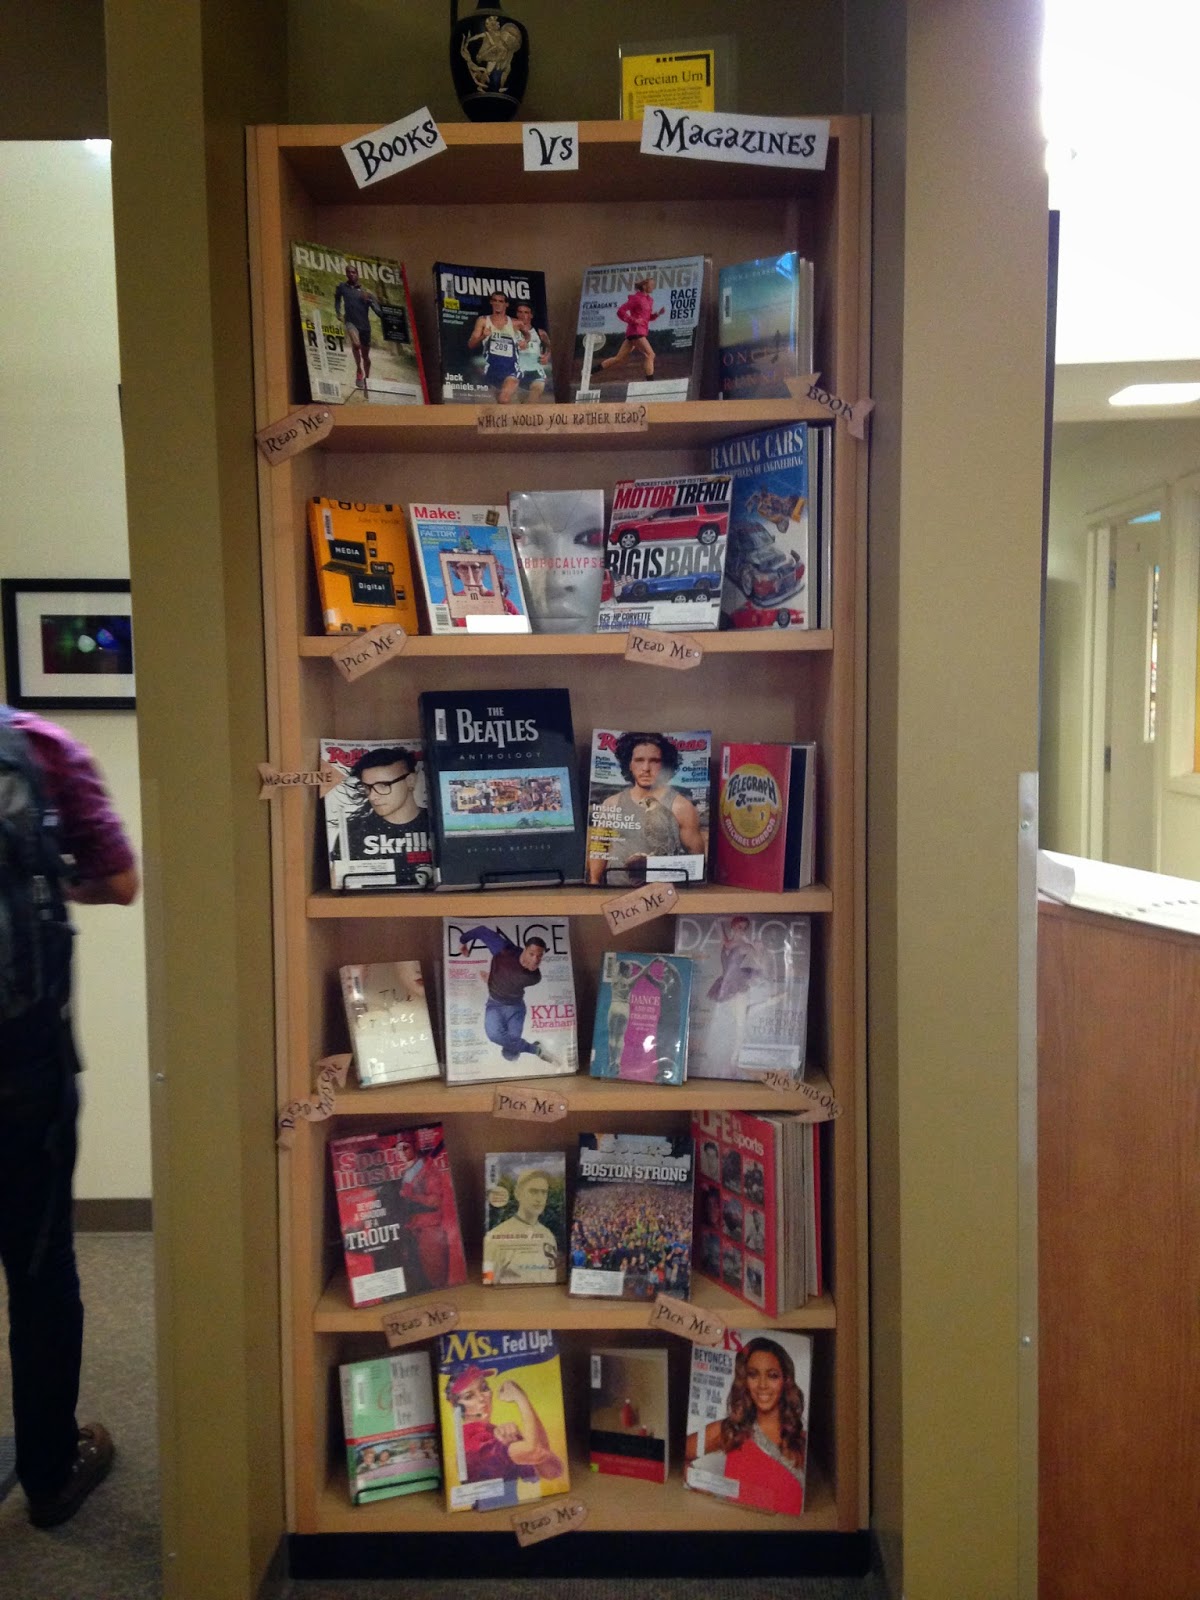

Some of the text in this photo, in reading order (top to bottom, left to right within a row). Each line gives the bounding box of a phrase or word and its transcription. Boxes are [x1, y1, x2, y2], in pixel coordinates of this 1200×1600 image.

[634, 71, 704, 86] Grecian Urn
[295, 246, 396, 285] RUNNING
[584, 267, 692, 296] RUNNING
[671, 288, 697, 300] RACE
[670, 298, 696, 310] YOUR
[670, 309, 695, 320] BEST
[308, 330, 346, 353] RST
[494, 343, 508, 351] 209
[445, 372, 463, 381] Jack
[807, 384, 853, 420] BOOK
[511, 414, 544, 427] WOULD
[710, 428, 804, 471] RACING CARS
[762, 456, 804, 473] ENGINEERING
[672, 478, 685, 486] EVER
[613, 481, 730, 510] MOTOR TREND
[414, 506, 461, 520] Make:
[420, 530, 457, 538] FACTORY
[335, 546, 361, 556] MEDIA
[605, 545, 726, 579] BIG IS BACK
[358, 582, 386, 592] Digital
[487, 706, 504, 717] THE
[456, 708, 539, 748] BEATLES
[459, 751, 542, 761] ANTHOLOGY
[728, 774, 777, 805] TELEGRAPH
[592, 803, 622, 814] Inside
[592, 811, 635, 822] GAME of
[591, 819, 641, 830] THRONES
[751, 818, 777, 847] CHABON
[531, 1004, 575, 1020] KYLE
[531, 1018, 577, 1030] Abraham
[581, 1163, 633, 1179] BOSTON
[635, 1165, 688, 1182] STRONG
[345, 1223, 401, 1251] TROUT
[442, 1329, 553, 1364] Ms. Fed Up!
